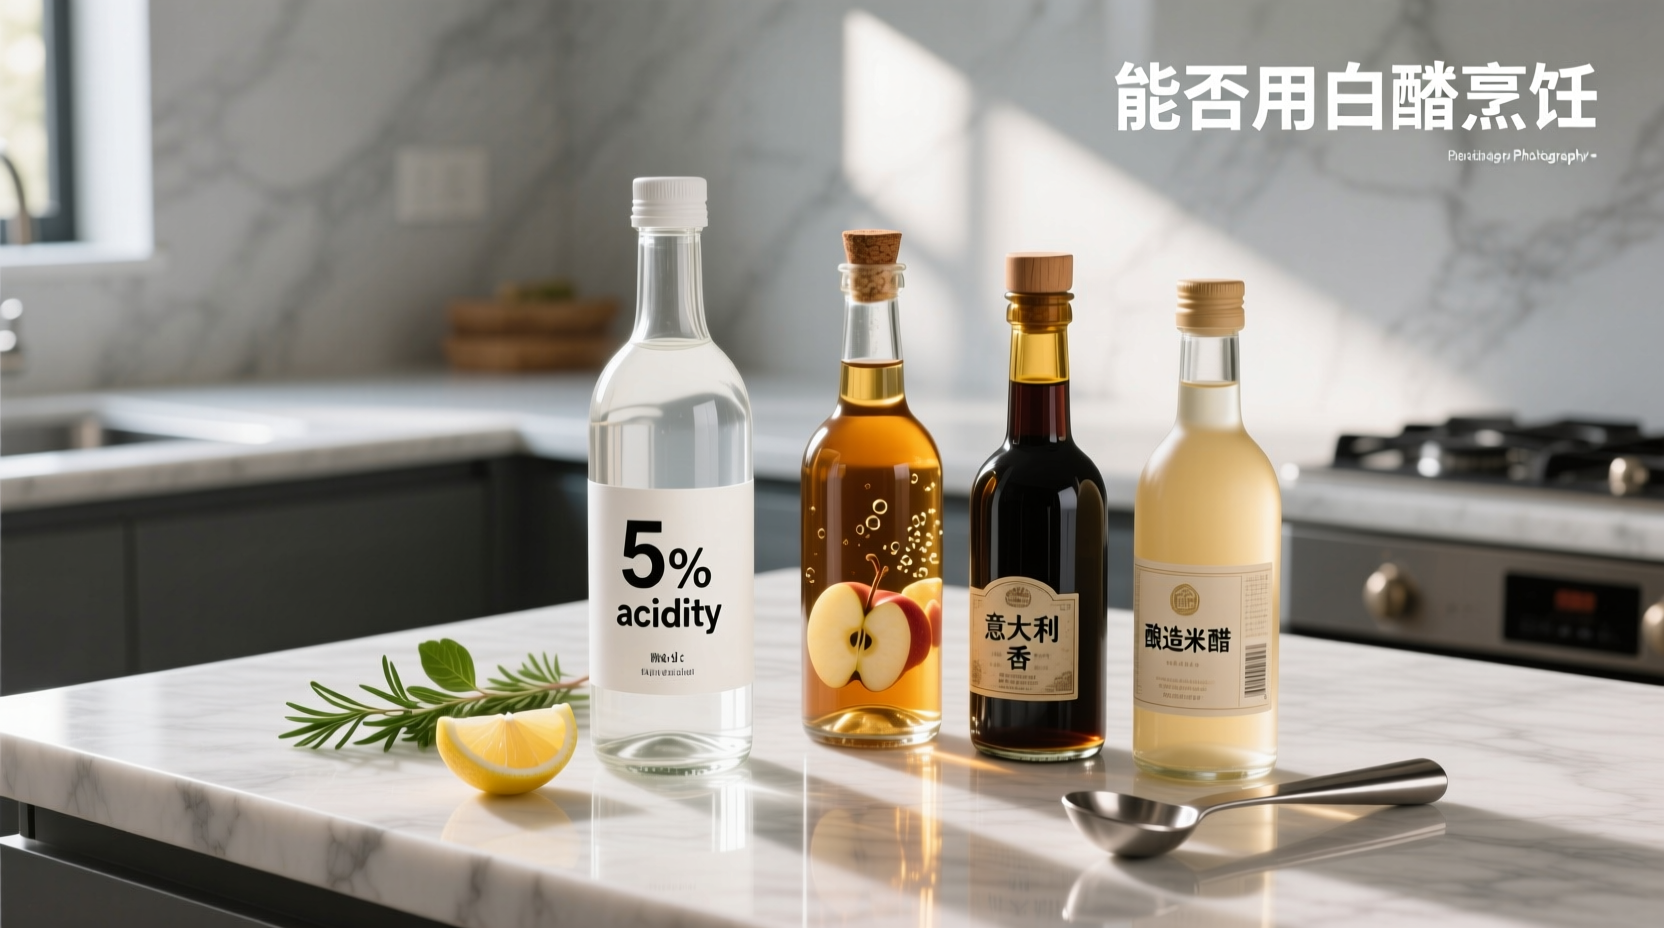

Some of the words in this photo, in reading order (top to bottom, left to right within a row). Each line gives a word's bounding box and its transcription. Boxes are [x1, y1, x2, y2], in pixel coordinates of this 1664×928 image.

[621, 520, 712, 589] 5%
[617, 597, 722, 635] acidity
[985, 611, 1059, 644] 意大利
[1144, 623, 1231, 654] 酿造米醋
[1006, 645, 1031, 671] 香
